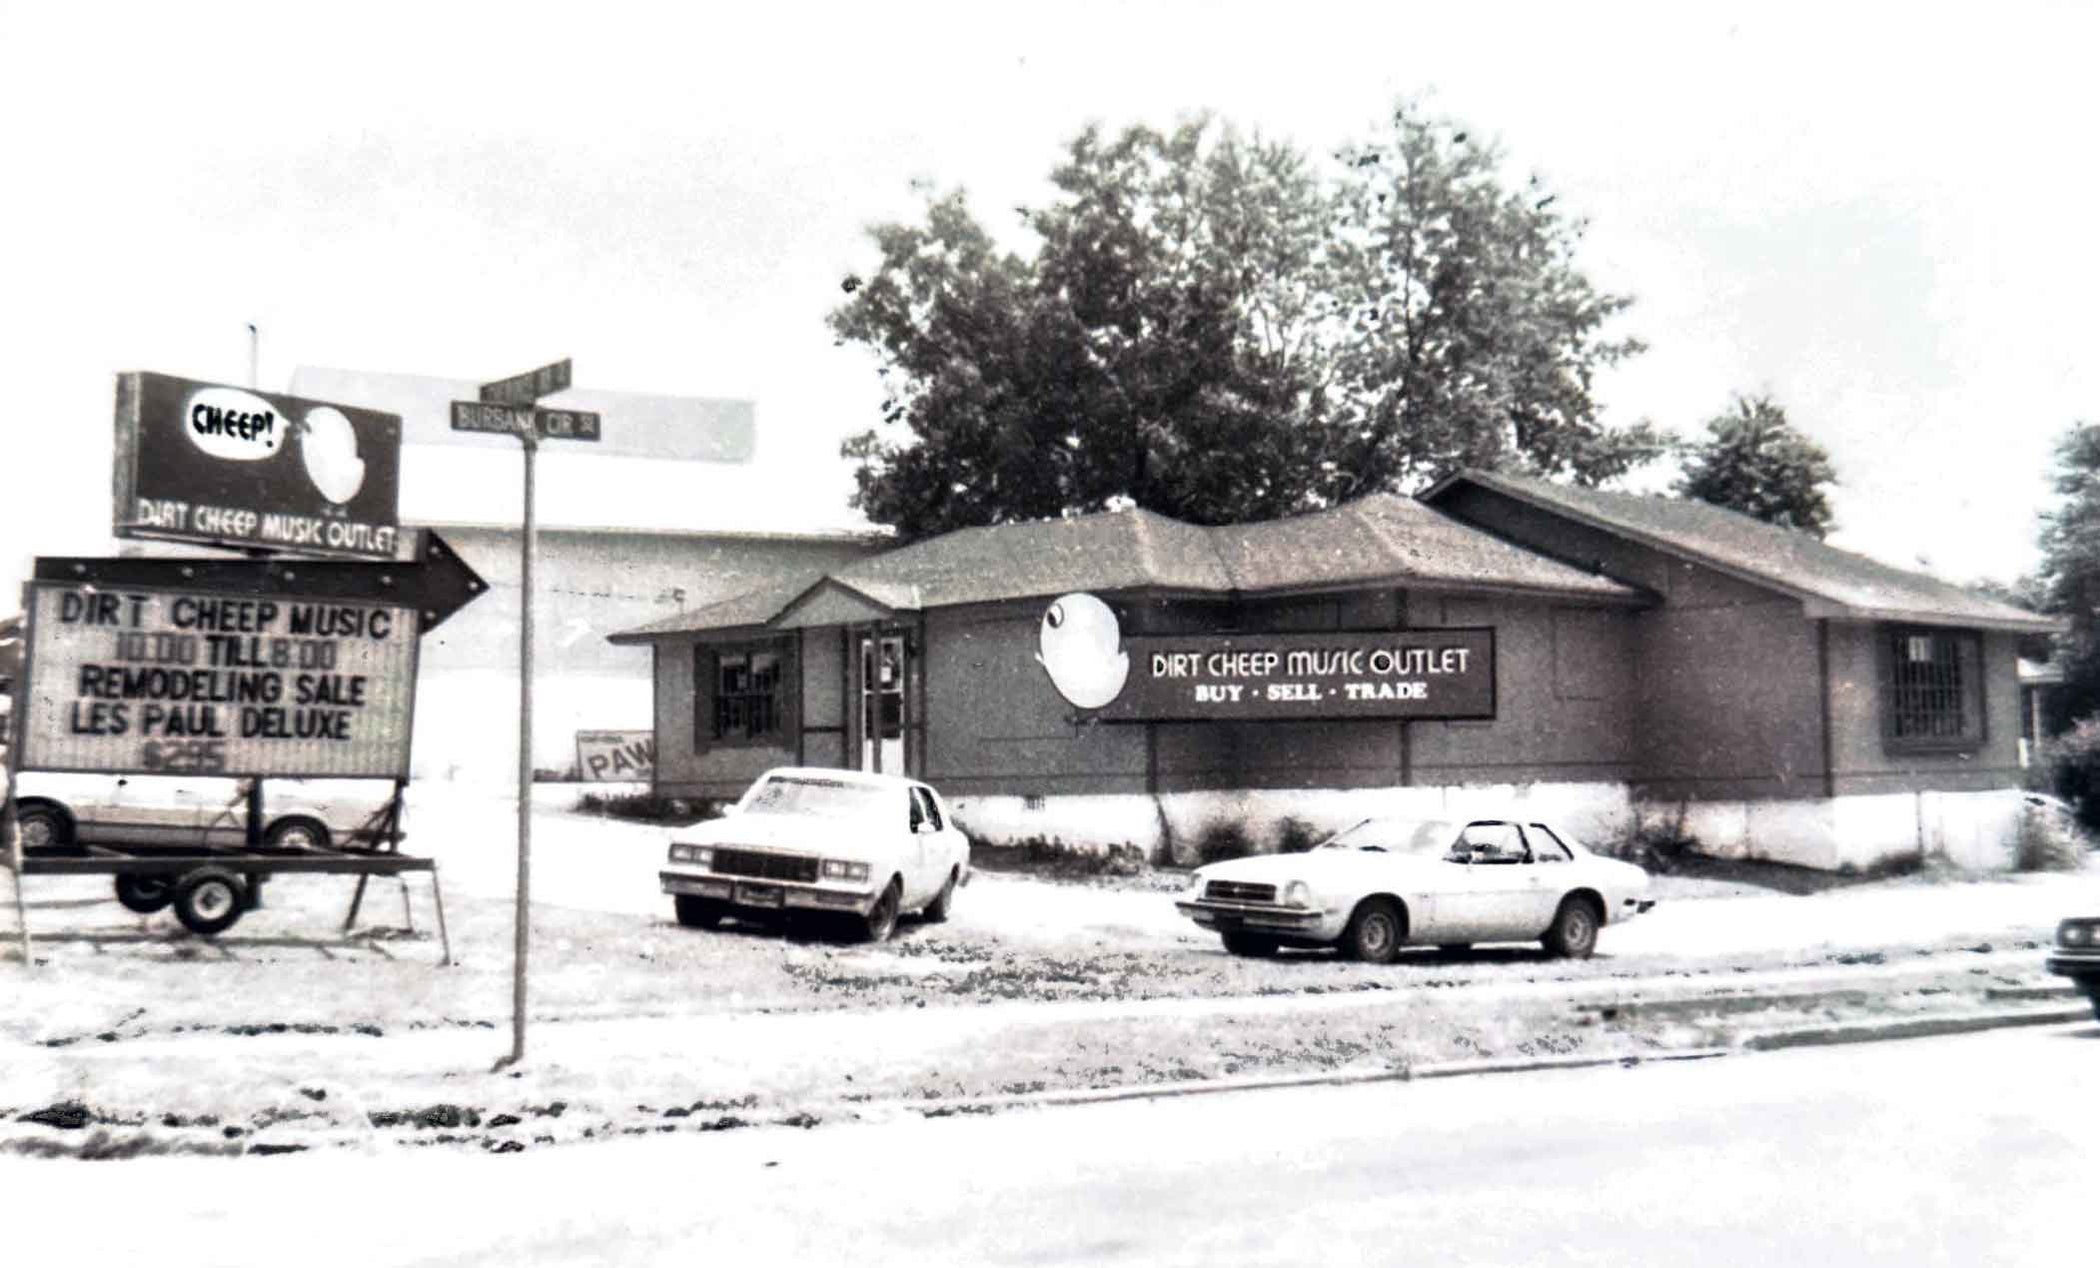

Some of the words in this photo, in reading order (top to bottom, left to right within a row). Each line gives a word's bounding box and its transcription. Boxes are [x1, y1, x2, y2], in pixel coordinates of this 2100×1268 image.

[192, 403, 274, 448] CHEEP!
[138, 499, 189, 529] DIRT
[194, 505, 257, 537] CHEEP
[261, 513, 323, 544] MUSIC
[326, 521, 397, 552] OUTLET
[62, 591, 150, 628] DIRT
[173, 597, 278, 633] CHEEP
[290, 604, 391, 640] MUSIC
[1152, 653, 1202, 678] DIRT
[1207, 652, 1280, 677] CHEEP
[1287, 650, 1364, 676] MUSIC
[1369, 648, 1471, 675] OUTLET
[79, 664, 282, 704] REMODELING
[295, 674, 367, 707] SALE
[1195, 684, 1244, 703] BUY
[1267, 683, 1323, 701] SELL
[1344, 682, 1429, 700] TRADE
[71, 701, 130, 735] LES
[143, 704, 225, 738] PAUL
[241, 707, 352, 741] DELUXE
